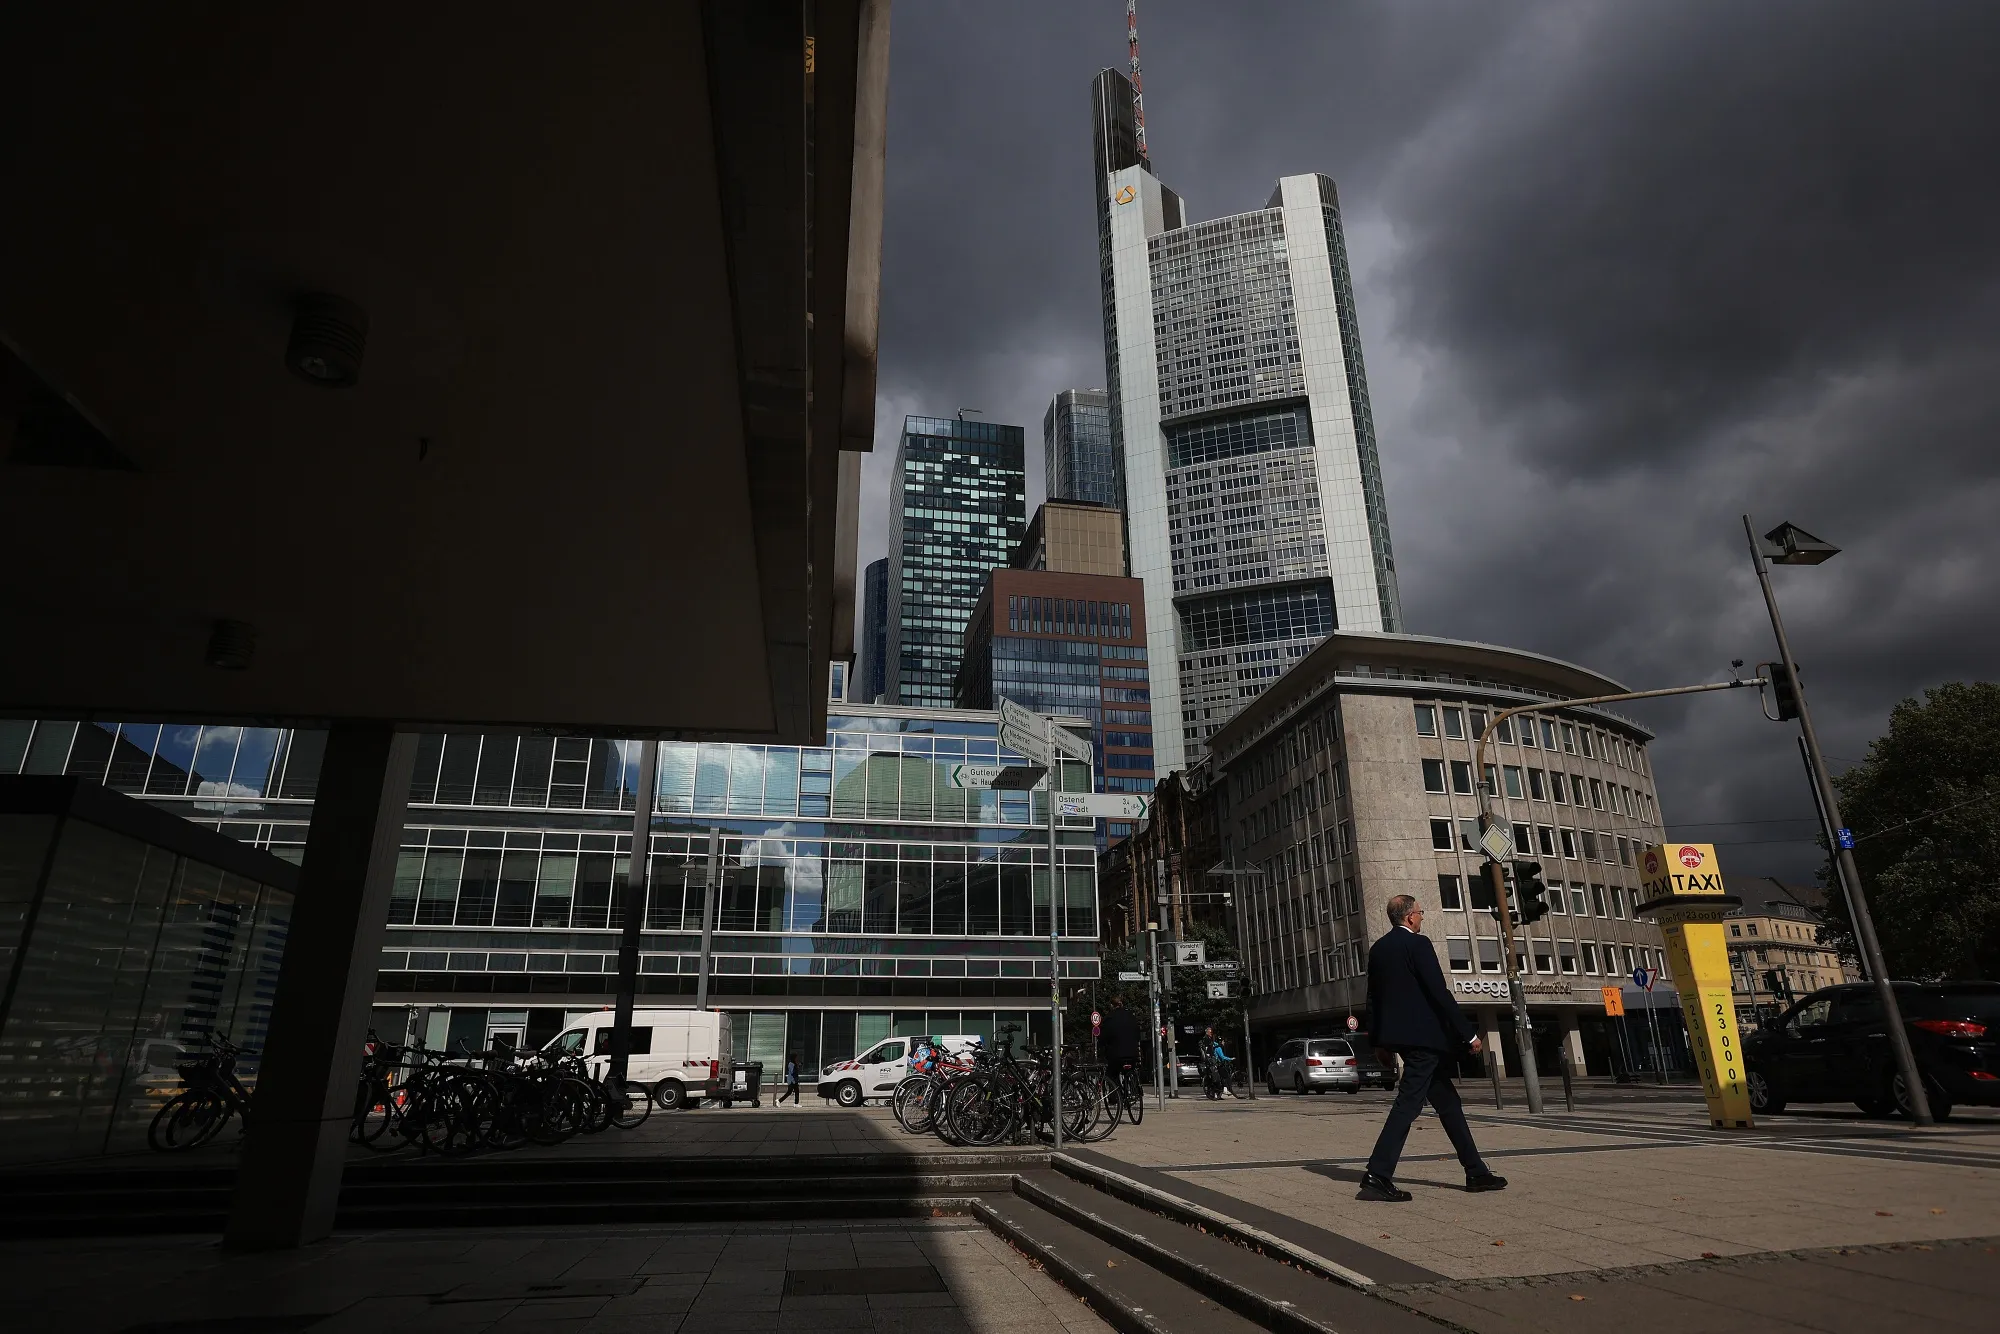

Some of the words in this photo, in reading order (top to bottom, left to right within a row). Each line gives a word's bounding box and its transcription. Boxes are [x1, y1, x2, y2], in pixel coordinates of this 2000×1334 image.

[1009, 728, 1030, 745] Niederrad
[970, 768, 1023, 778] Gutleutviertel
[980, 778, 1020, 787] Hauptbahnhof
[1058, 795, 1085, 804] Ostend
[1643, 874, 1673, 898] TAXI
[1671, 874, 1723, 891] TAXI
